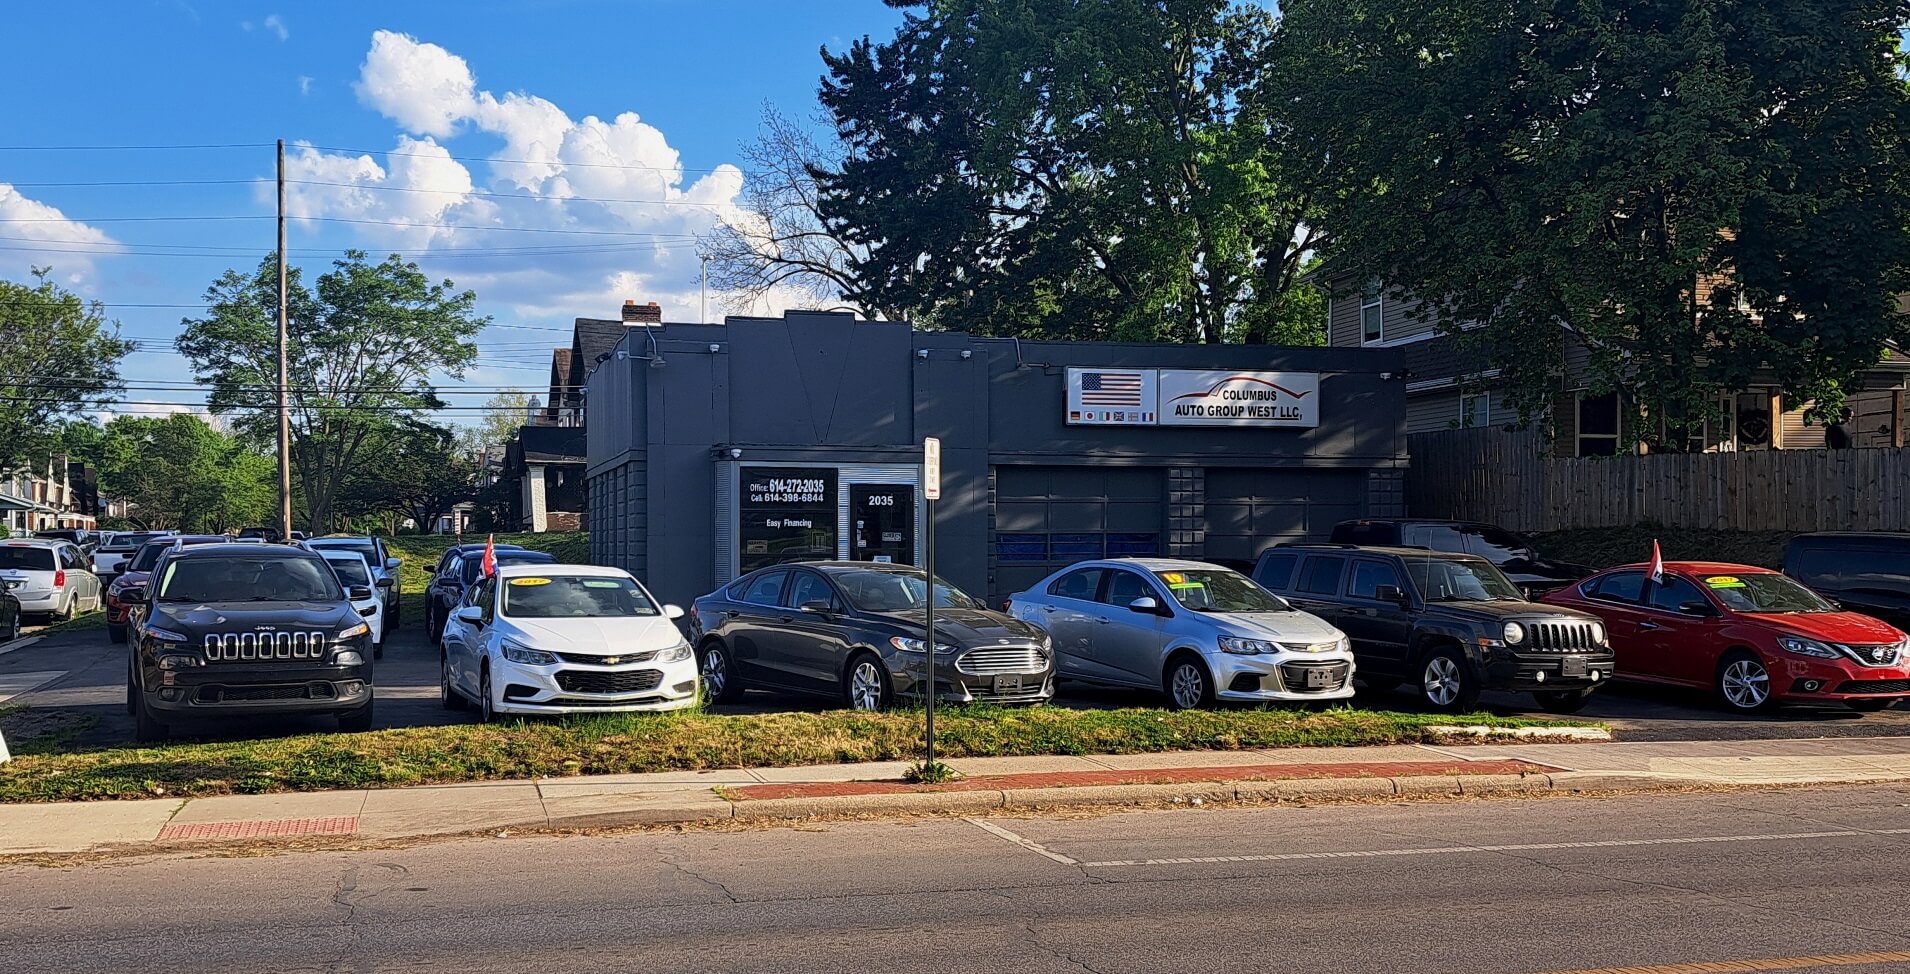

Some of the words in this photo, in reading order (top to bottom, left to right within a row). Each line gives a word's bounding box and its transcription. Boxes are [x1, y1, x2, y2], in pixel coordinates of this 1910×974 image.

[1222, 390, 1277, 401] COLUMBUS
[1174, 404, 1204, 416] AUTO
[1207, 405, 1245, 417] GROUP
[1247, 406, 1277, 418] WEST
[769, 479, 824, 493] 614-272-2035
[764, 493, 824, 502] 614-398-6844
[868, 495, 894, 506] 2035
[766, 519, 781, 529] Easy
[783, 518, 812, 529] Financing
